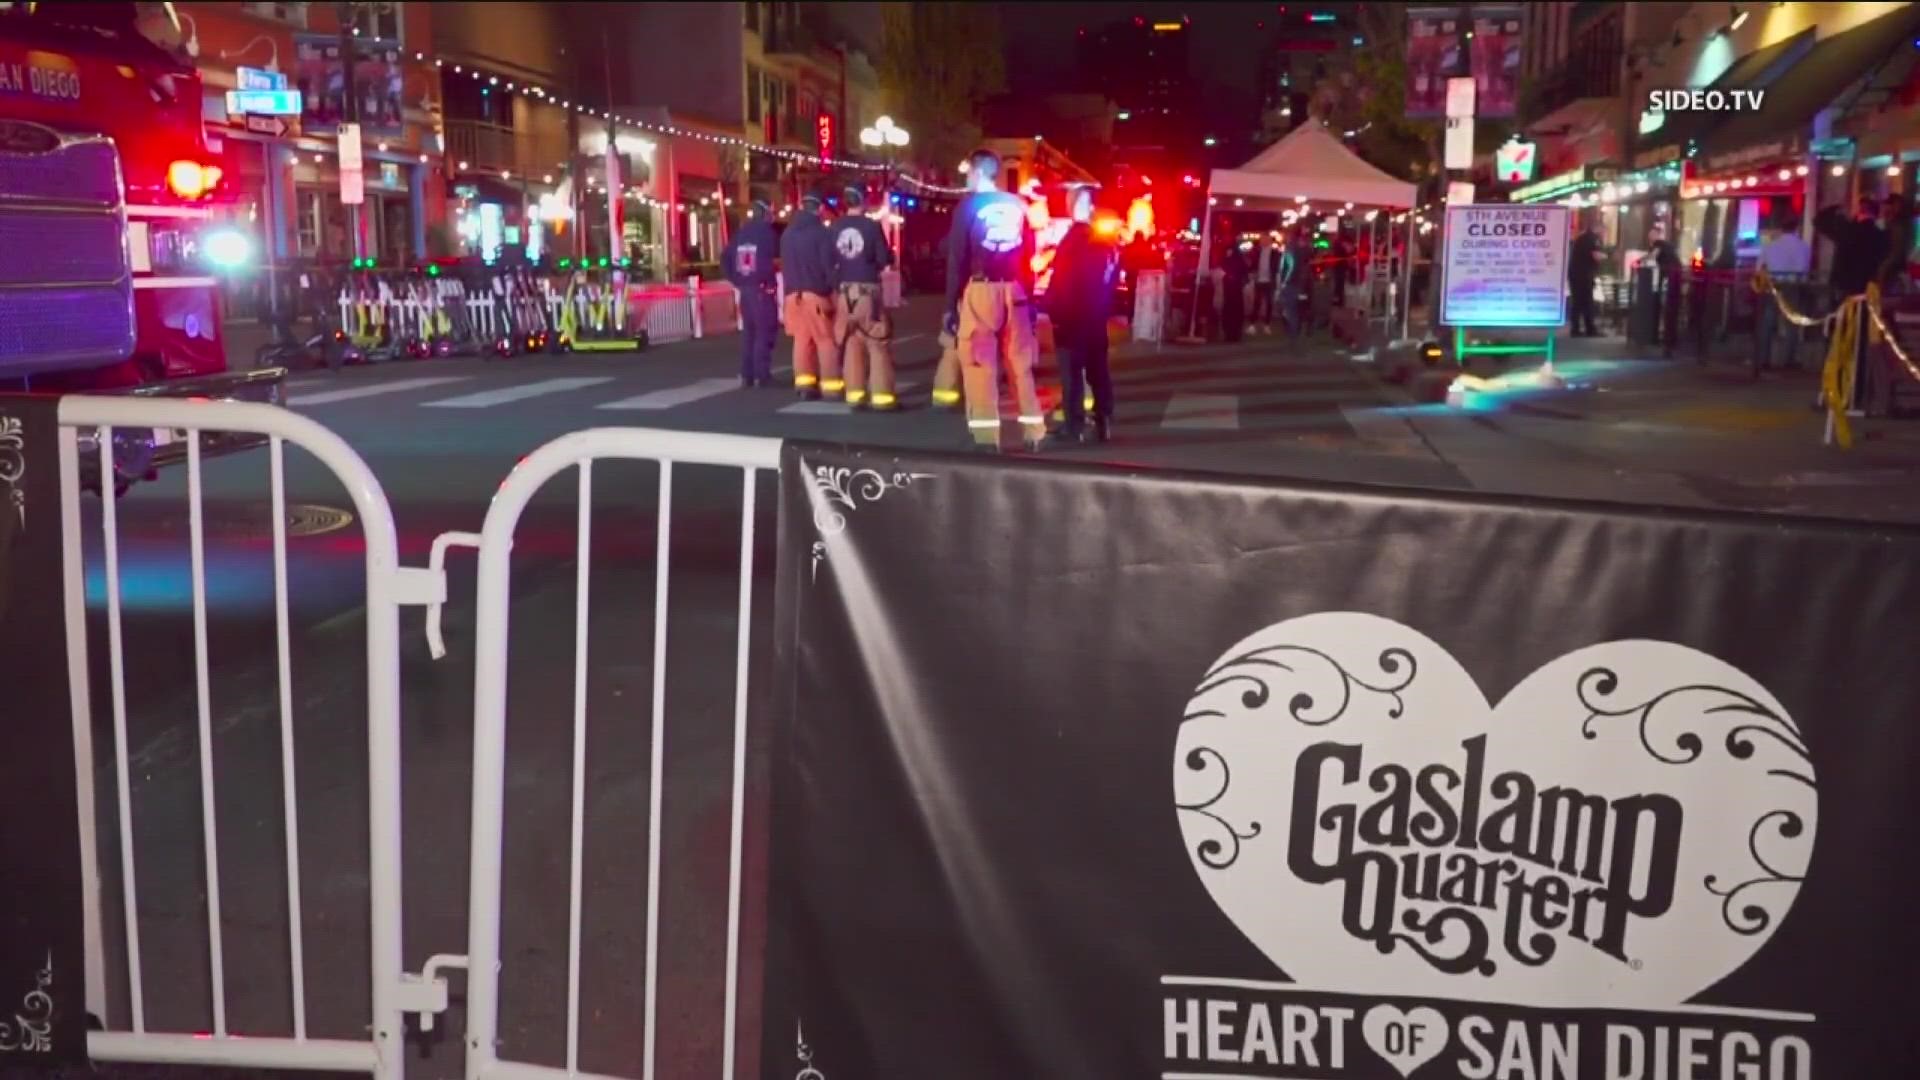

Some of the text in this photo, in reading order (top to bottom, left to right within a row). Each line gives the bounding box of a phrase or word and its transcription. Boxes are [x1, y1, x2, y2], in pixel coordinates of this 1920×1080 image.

[30, 66, 81, 99] DIEGO
[1466, 210, 1548, 222] 5TH AVENUE
[1467, 223, 1547, 237] CLOSED
[1461, 239, 1551, 249] DURING COVID
[1287, 734, 1683, 963] Gaslamp
[1163, 997, 1812, 1080] HEART OF SAN DIEGO
